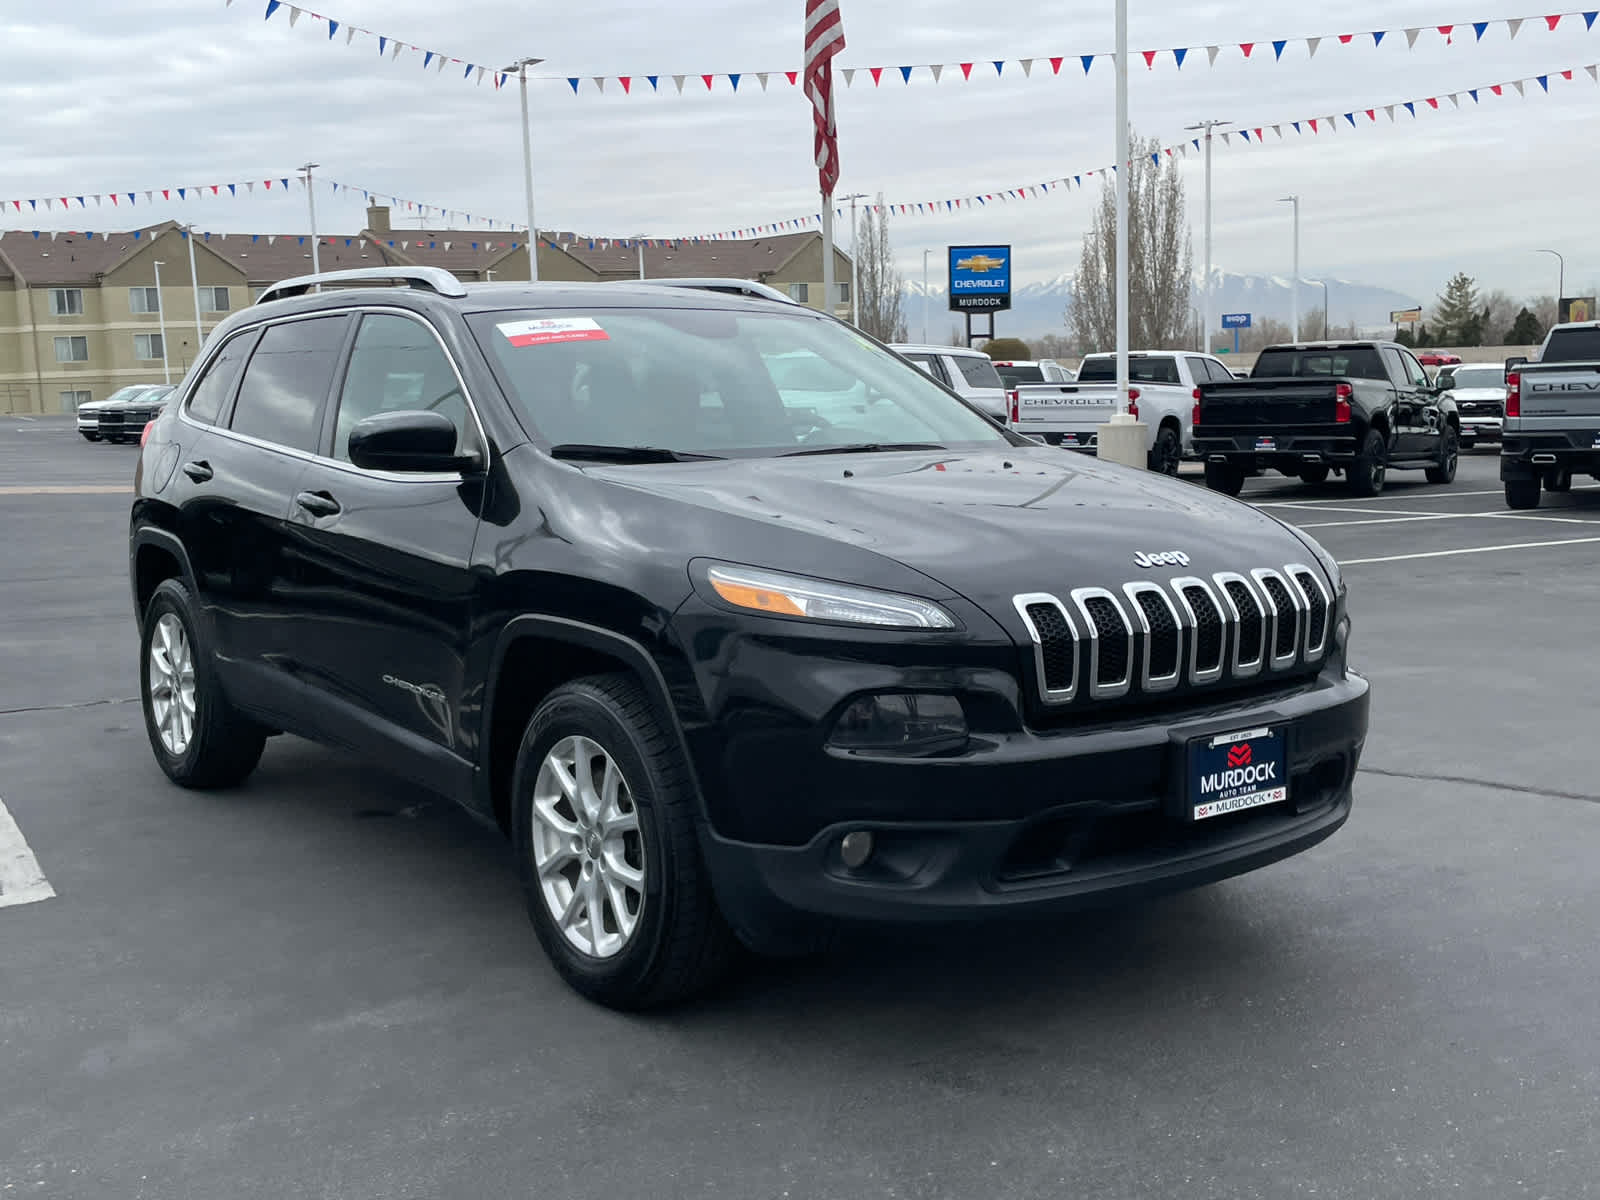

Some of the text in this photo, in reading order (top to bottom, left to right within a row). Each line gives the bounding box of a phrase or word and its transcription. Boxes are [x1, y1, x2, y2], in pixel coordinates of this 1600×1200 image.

[954, 279, 1005, 288] CHEVROLET
[959, 298, 1001, 306] MURDOCK
[1023, 398, 1114, 406] CHEVROLET
[1134, 550, 1190, 568] Jeep
[1200, 761, 1276, 794] MURDOCK
[1219, 784, 1257, 799] AUTO TEAM
[1216, 793, 1266, 813] MURDOCK
